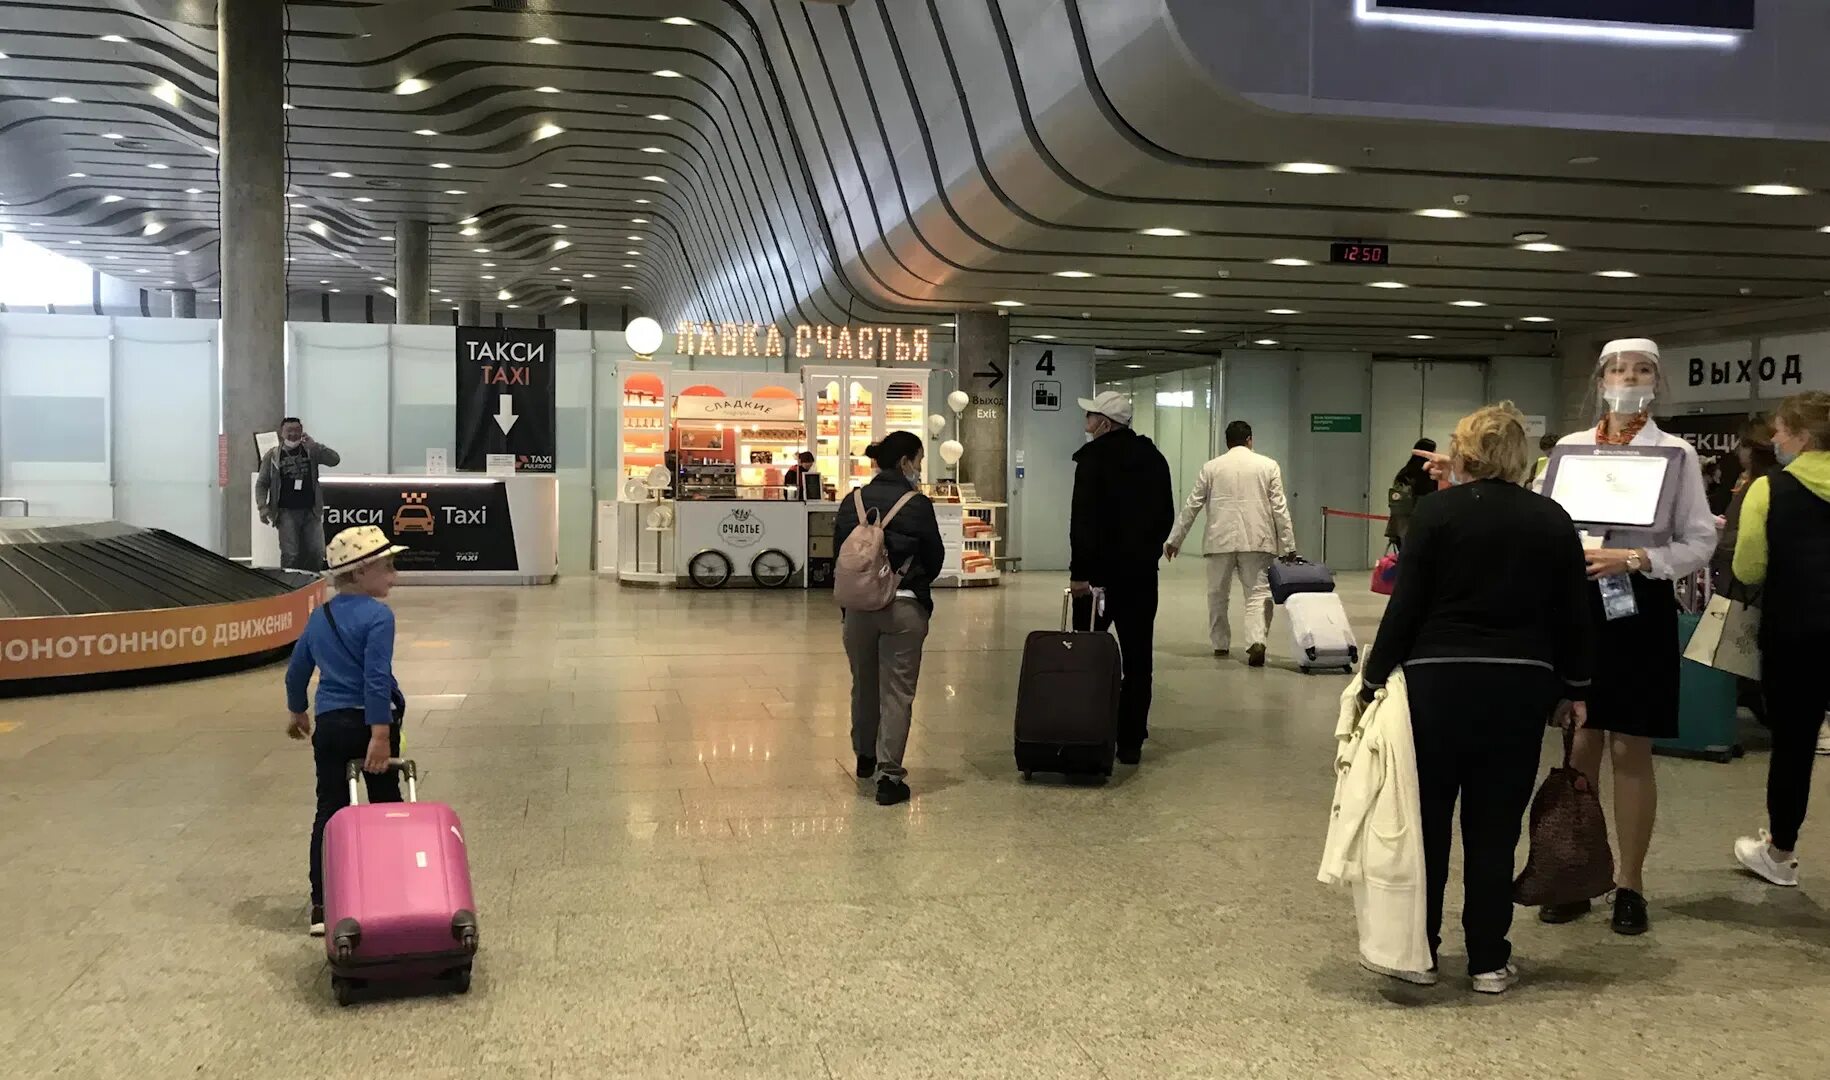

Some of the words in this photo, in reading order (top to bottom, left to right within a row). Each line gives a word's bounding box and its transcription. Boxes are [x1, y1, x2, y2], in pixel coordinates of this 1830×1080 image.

[677, 320, 783, 357] ЛАВКА
[796, 325, 928, 361] СЧАСТЬЯ
[466, 341, 544, 362] ТАКСИ
[1035, 350, 1055, 376] 4
[1689, 354, 1802, 386] Выход
[481, 365, 530, 386] TAXI
[704, 400, 773, 414] СЛАДКИЕ
[972, 395, 1004, 406] Выход
[977, 409, 997, 419] Exit
[531, 455, 552, 463] TAXI
[441, 506, 487, 524] Taxi
[722, 524, 760, 534] СЧАСТЬЕ
[0, 626, 207, 662] онотонного
[213, 611, 293, 647] движения
